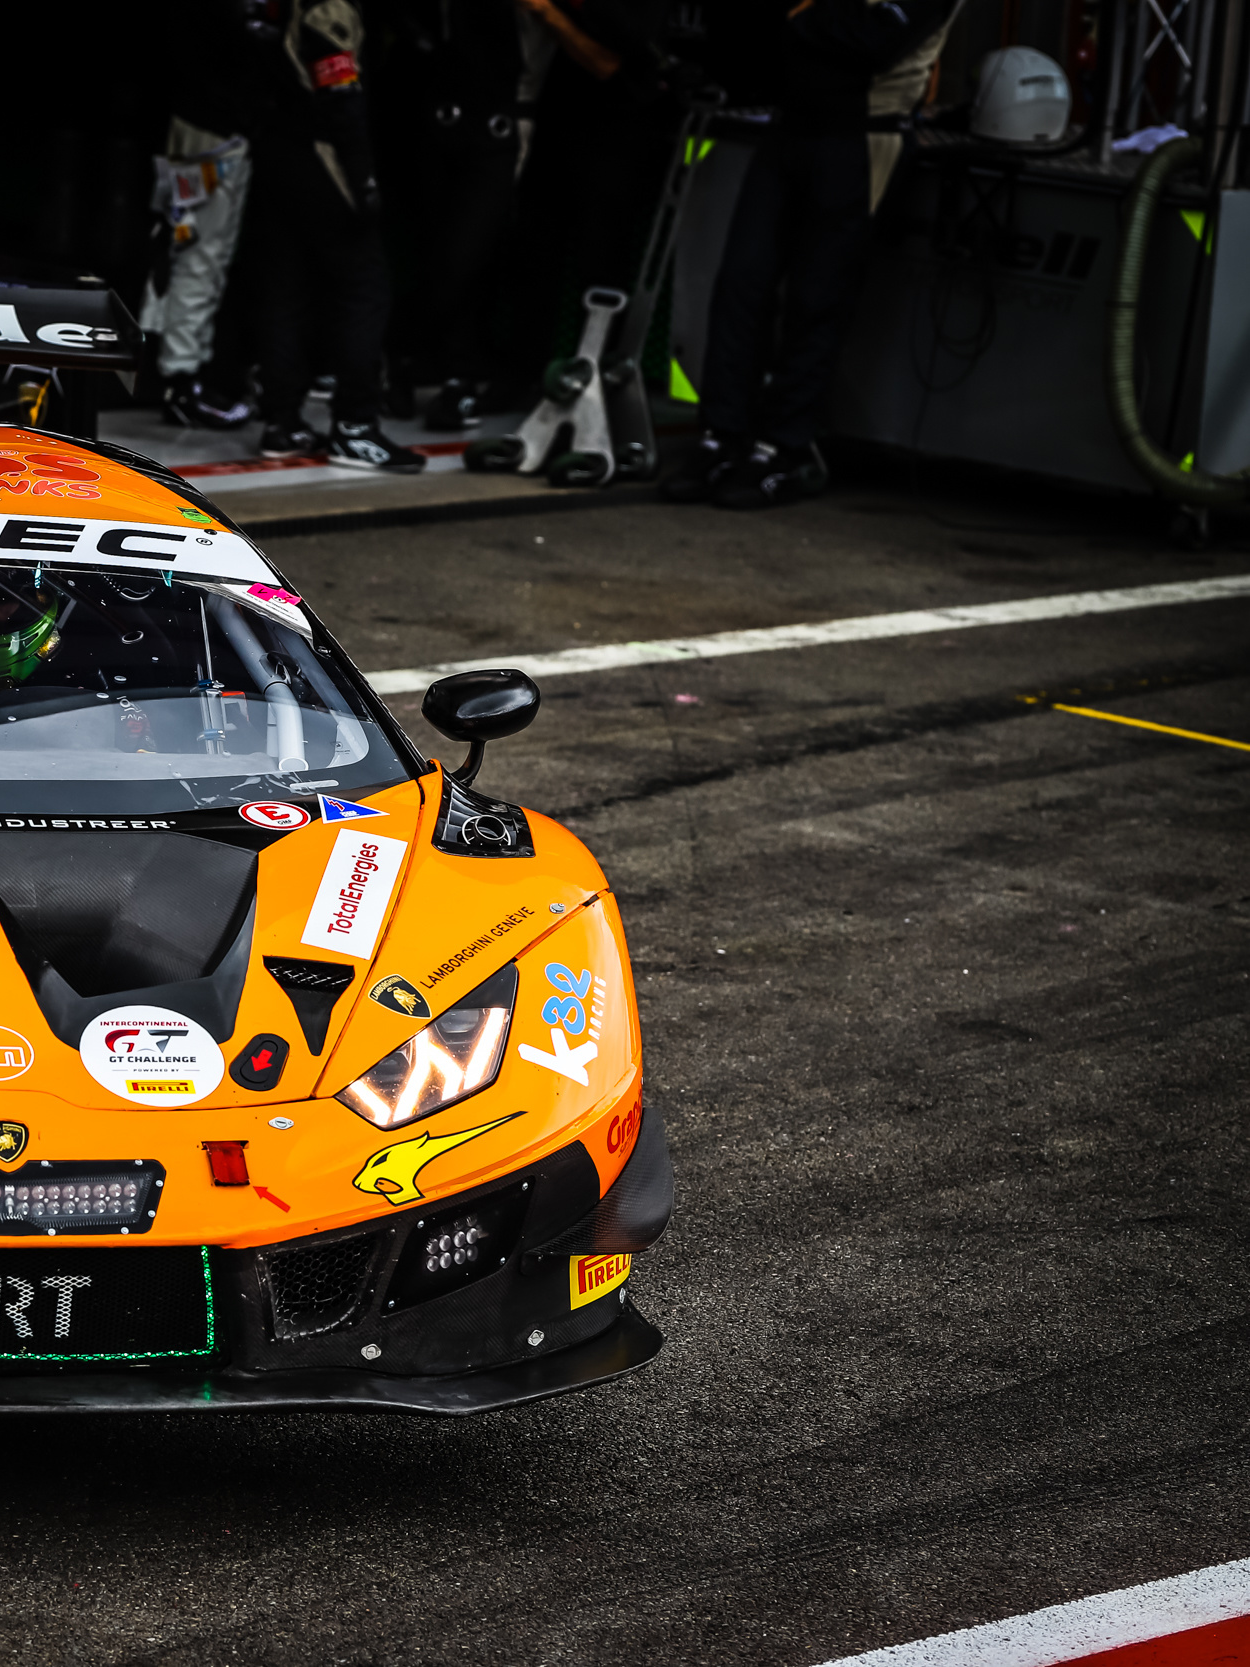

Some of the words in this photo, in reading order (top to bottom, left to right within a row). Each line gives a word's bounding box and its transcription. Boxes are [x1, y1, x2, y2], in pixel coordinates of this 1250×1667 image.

[254, 805, 291, 821] E
[327, 842, 379, 935] TotalEnergies
[419, 934, 495, 990] LAMBORGHINI
[490, 906, 536, 938] GENÈVE
[587, 975, 608, 1040] RACING
[109, 1055, 125, 1063] GT
[127, 1055, 197, 1063] CHALLENGE
[131, 1081, 189, 1092] PIRELLI
